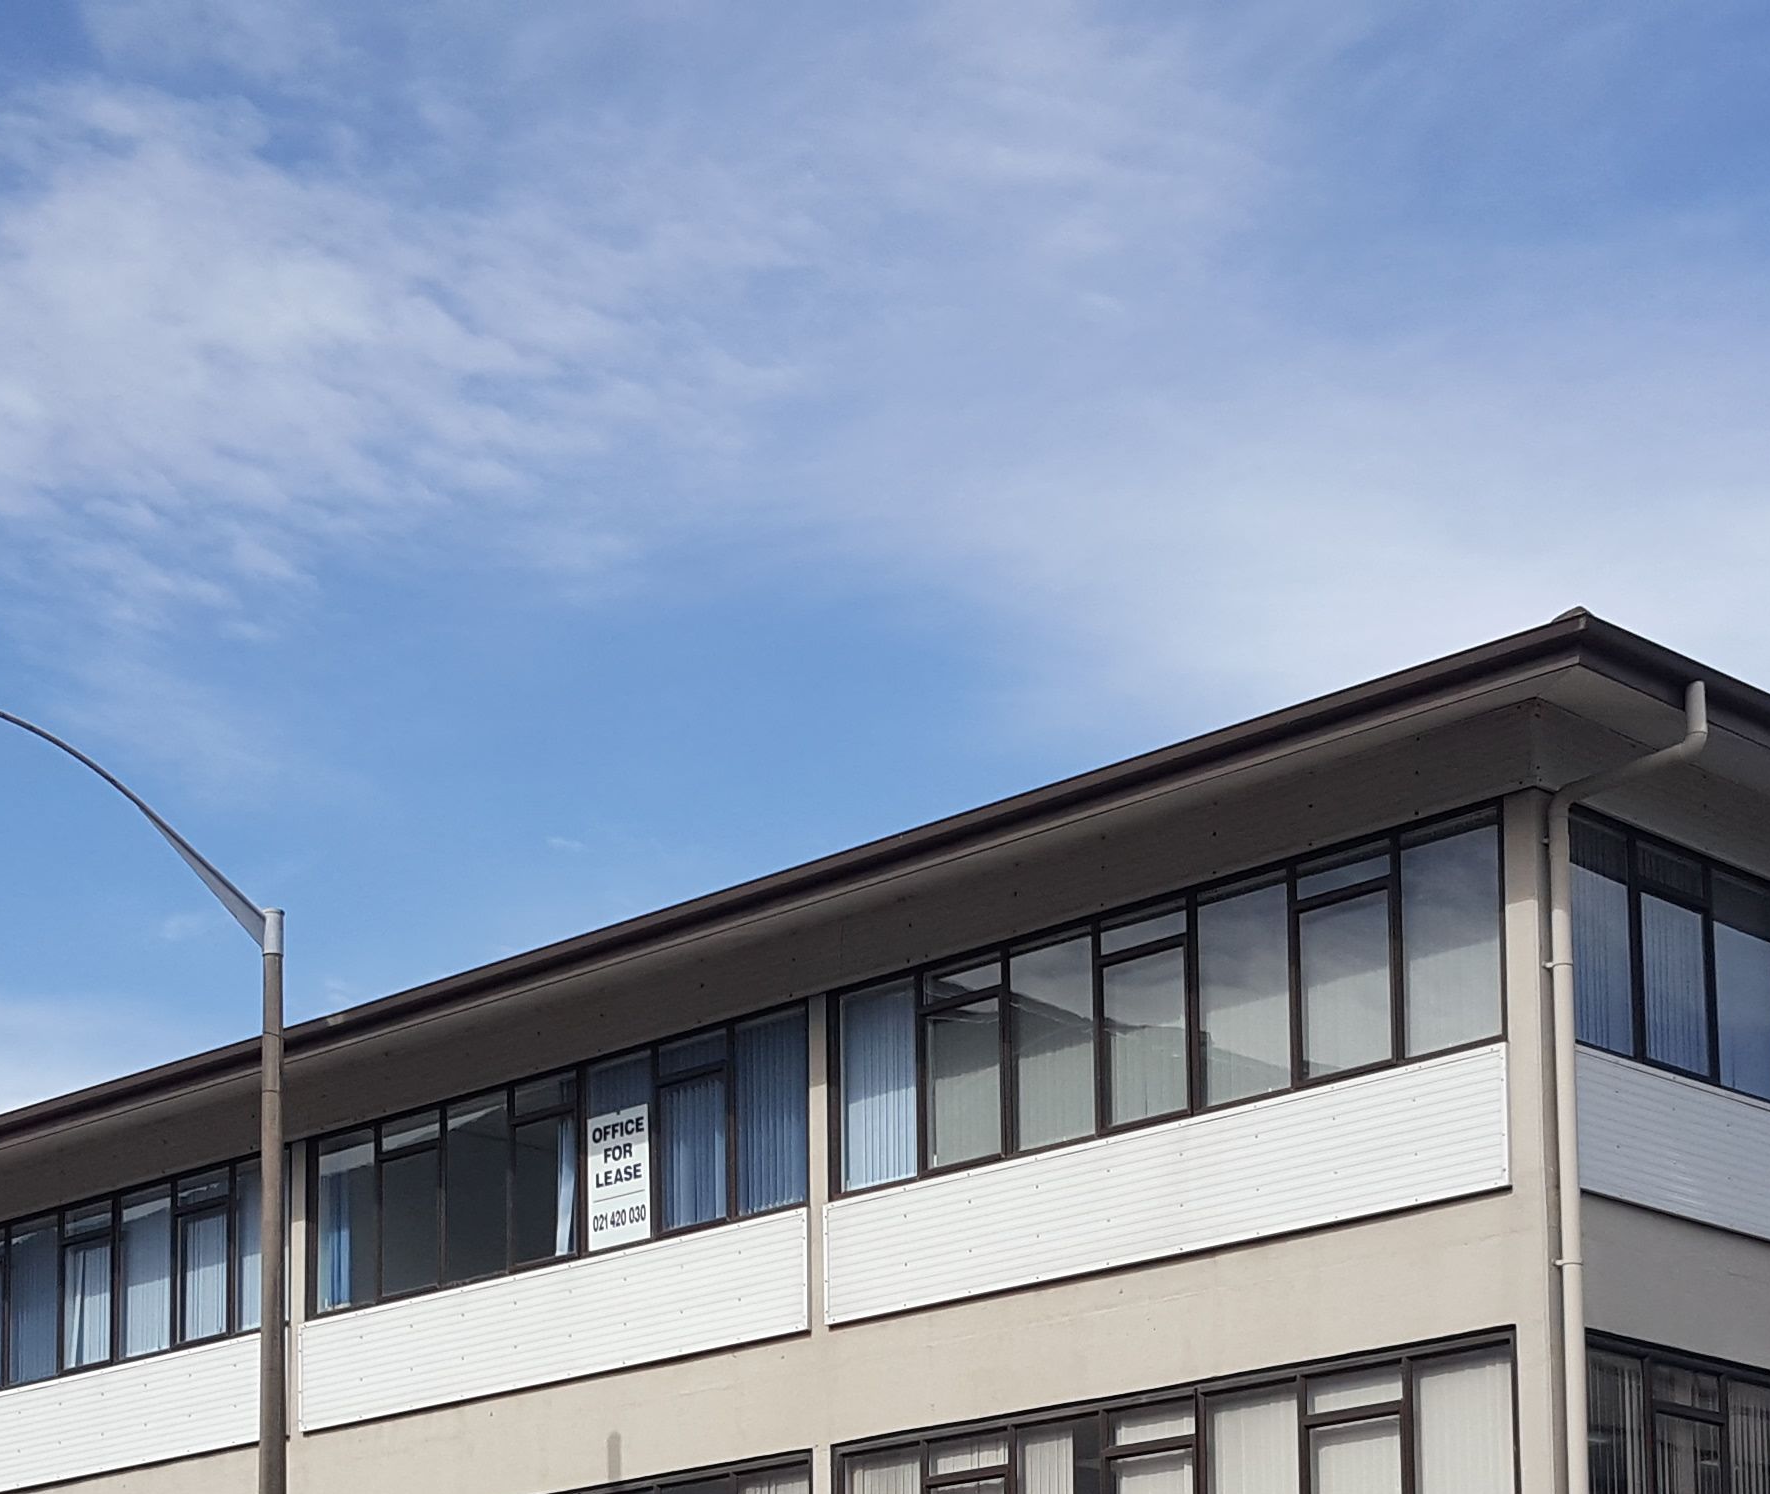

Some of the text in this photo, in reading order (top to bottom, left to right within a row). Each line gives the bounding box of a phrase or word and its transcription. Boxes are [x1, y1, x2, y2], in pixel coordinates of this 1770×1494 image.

[592, 1116, 644, 1143] OFFICE
[604, 1143, 632, 1164] FOR
[596, 1163, 642, 1188] LEASE
[593, 1204, 646, 1232] 021 420 030
